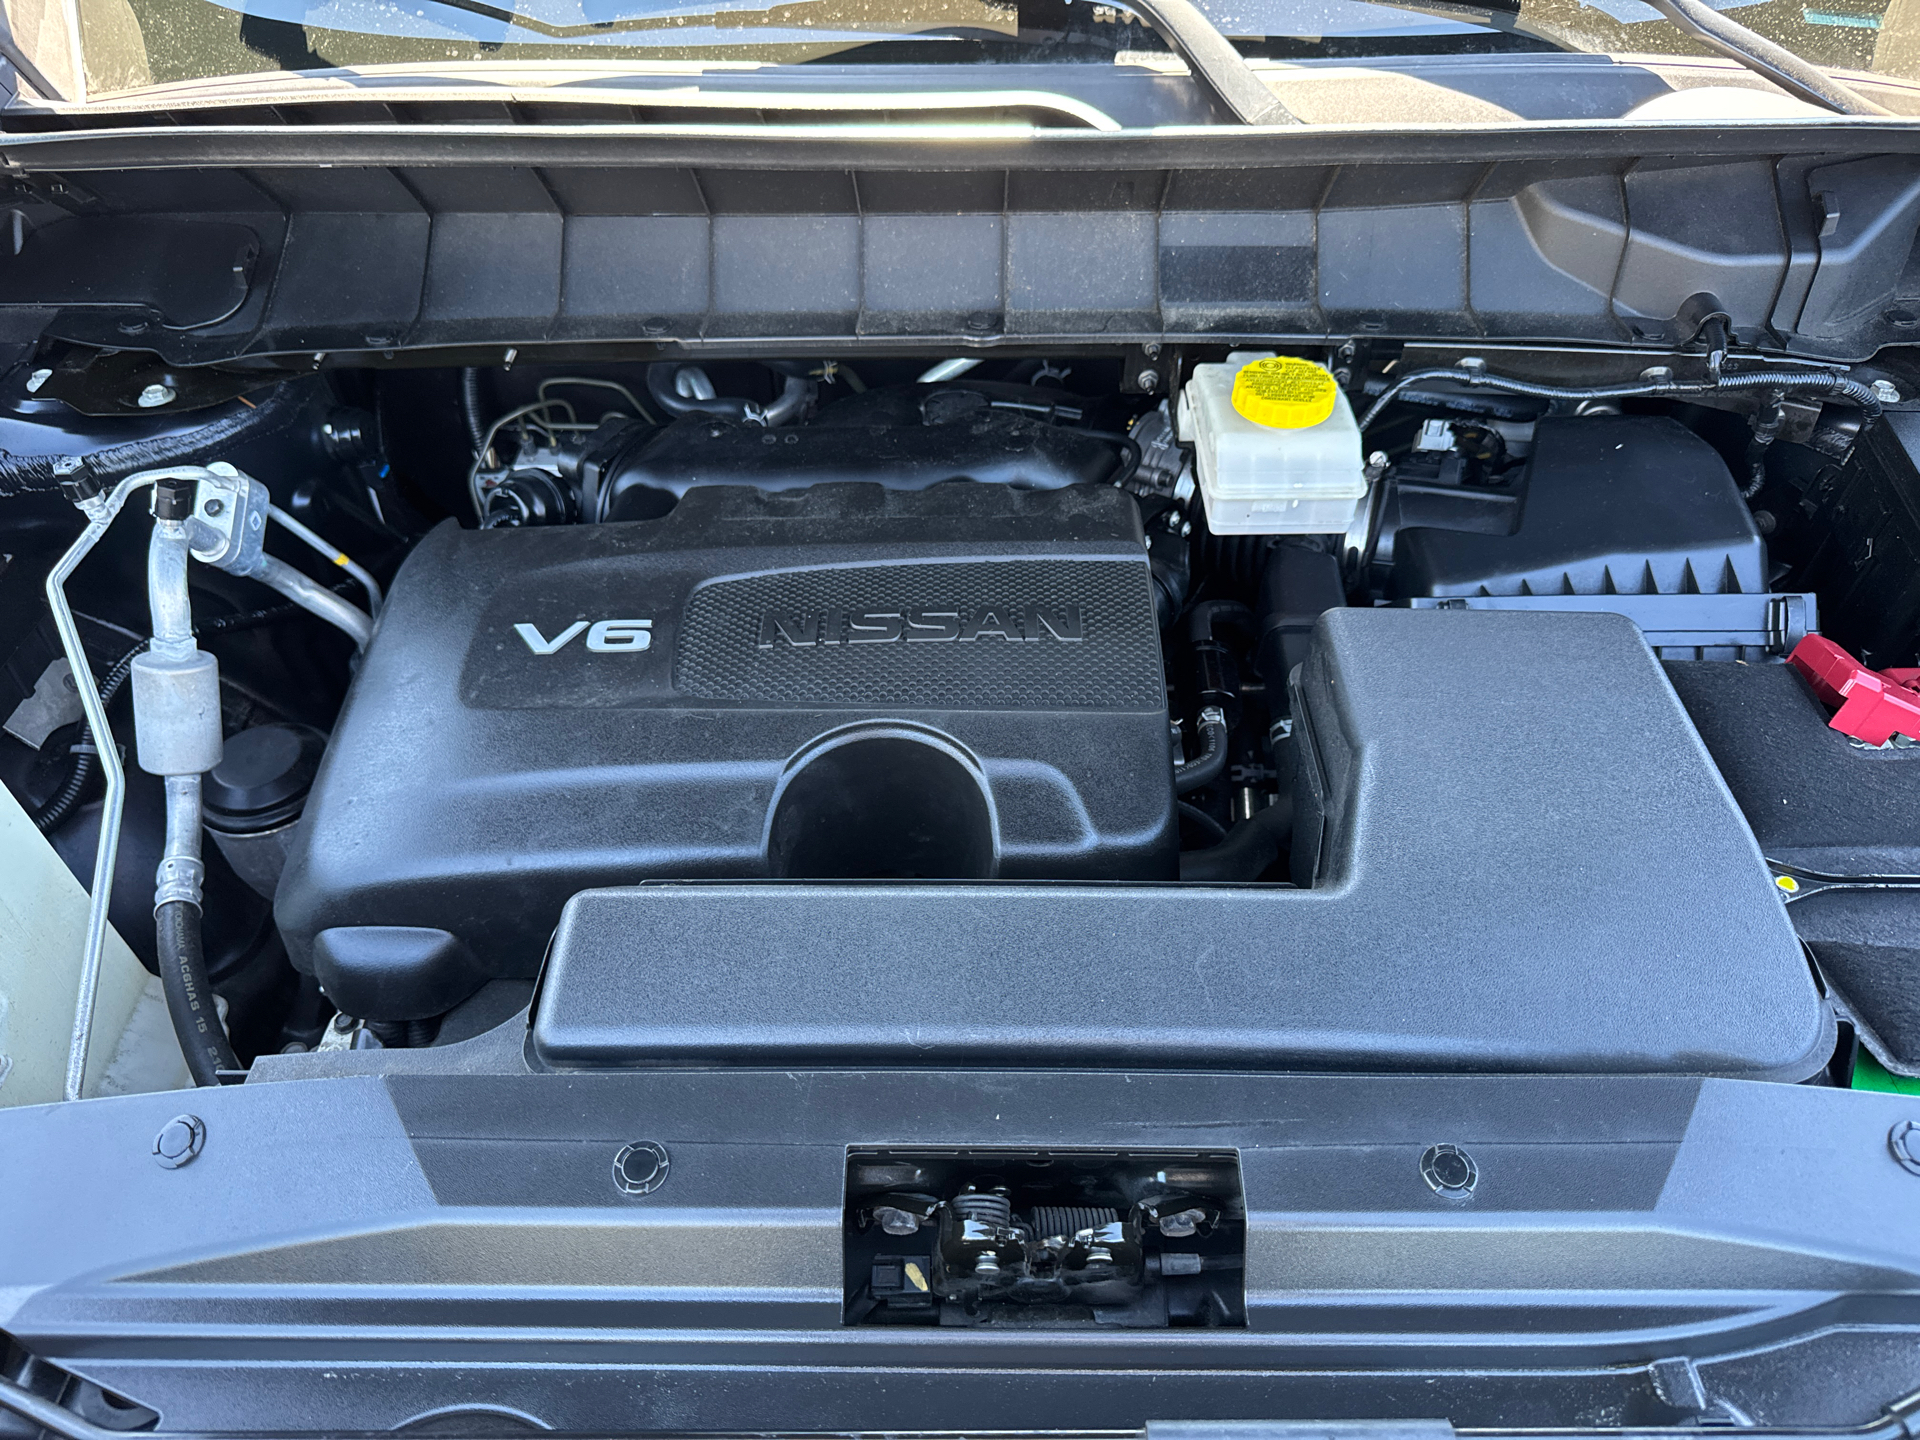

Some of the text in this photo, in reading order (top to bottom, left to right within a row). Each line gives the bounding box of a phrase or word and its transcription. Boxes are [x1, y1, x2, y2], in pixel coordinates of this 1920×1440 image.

[513, 619, 653, 656] V6
[758, 604, 1084, 649] NISSAN
[195, 1016, 208, 1033] 15
